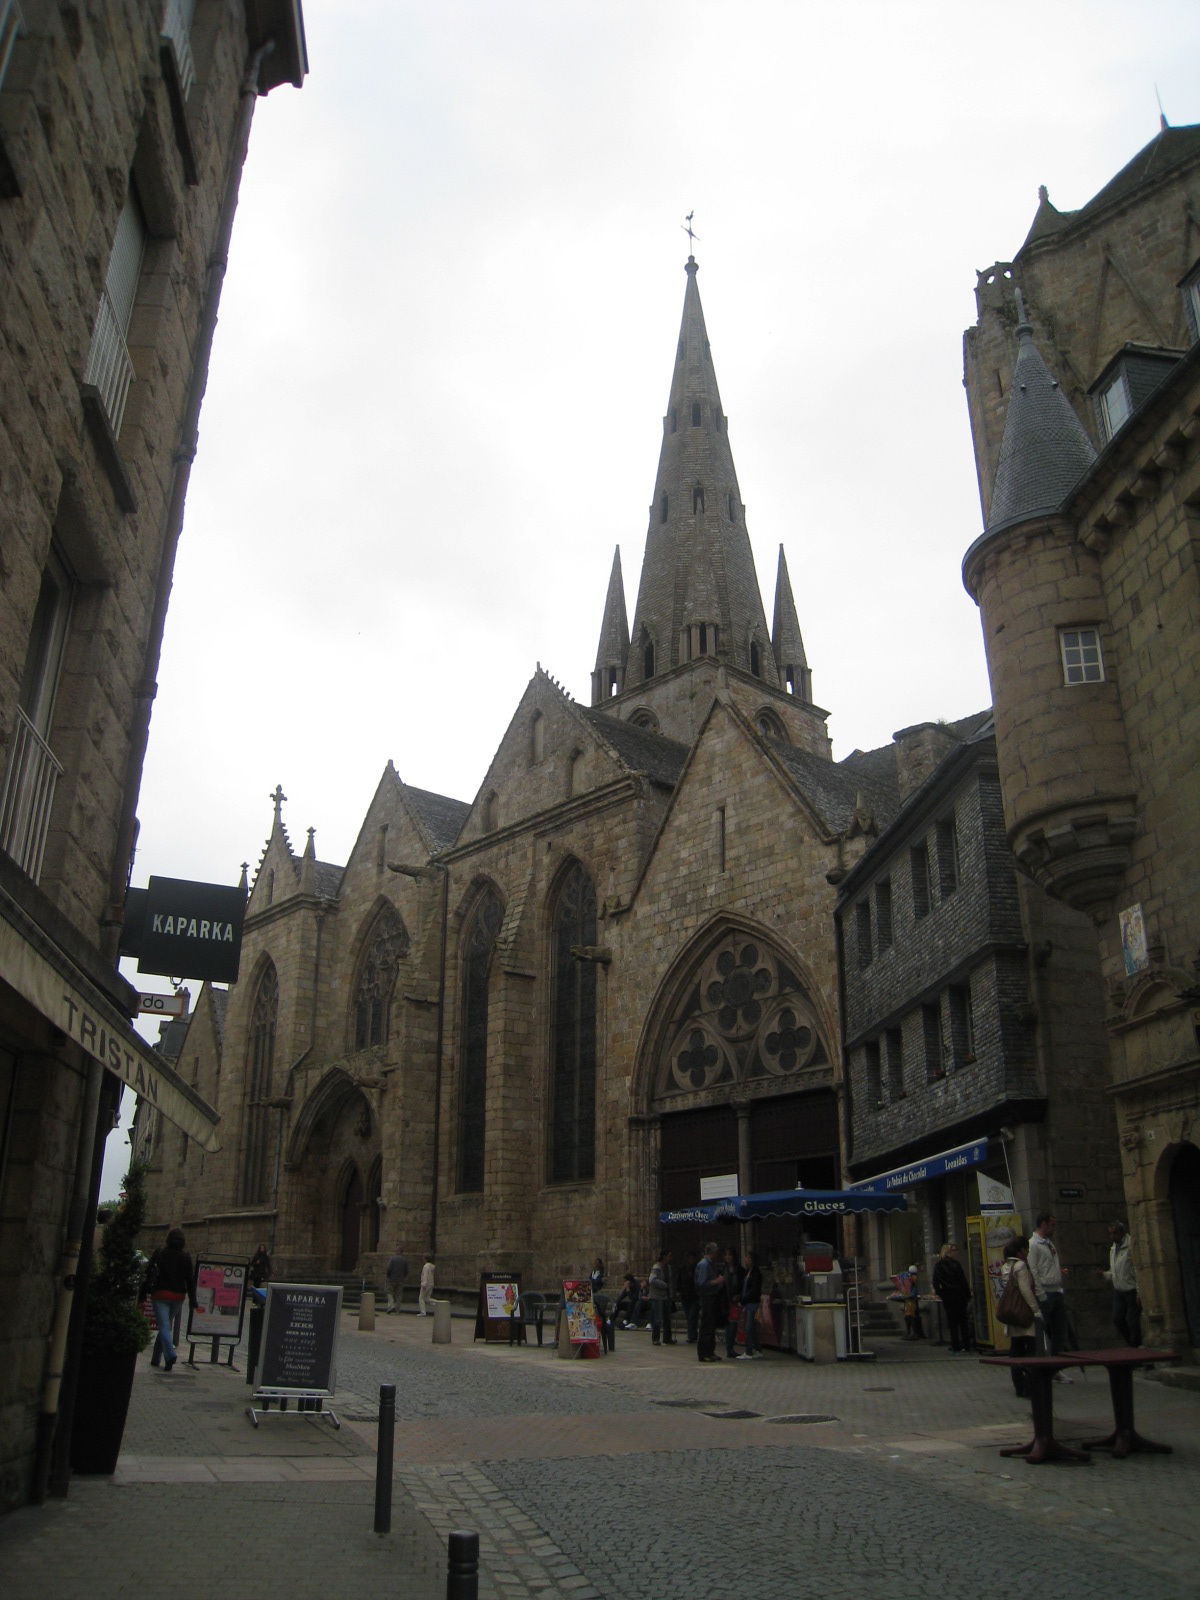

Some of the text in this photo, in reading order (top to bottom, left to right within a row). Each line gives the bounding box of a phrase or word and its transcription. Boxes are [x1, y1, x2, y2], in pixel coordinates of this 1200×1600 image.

[152, 913, 233, 942] KAPARKA
[139, 995, 164, 1010] da
[63, 994, 158, 1104] TRISTAN
[944, 1155, 968, 1171] Leonidas
[908, 1167, 927, 1181] Chocolat
[804, 1200, 846, 1211] Glaces
[286, 1294, 326, 1305] KAPARKA
